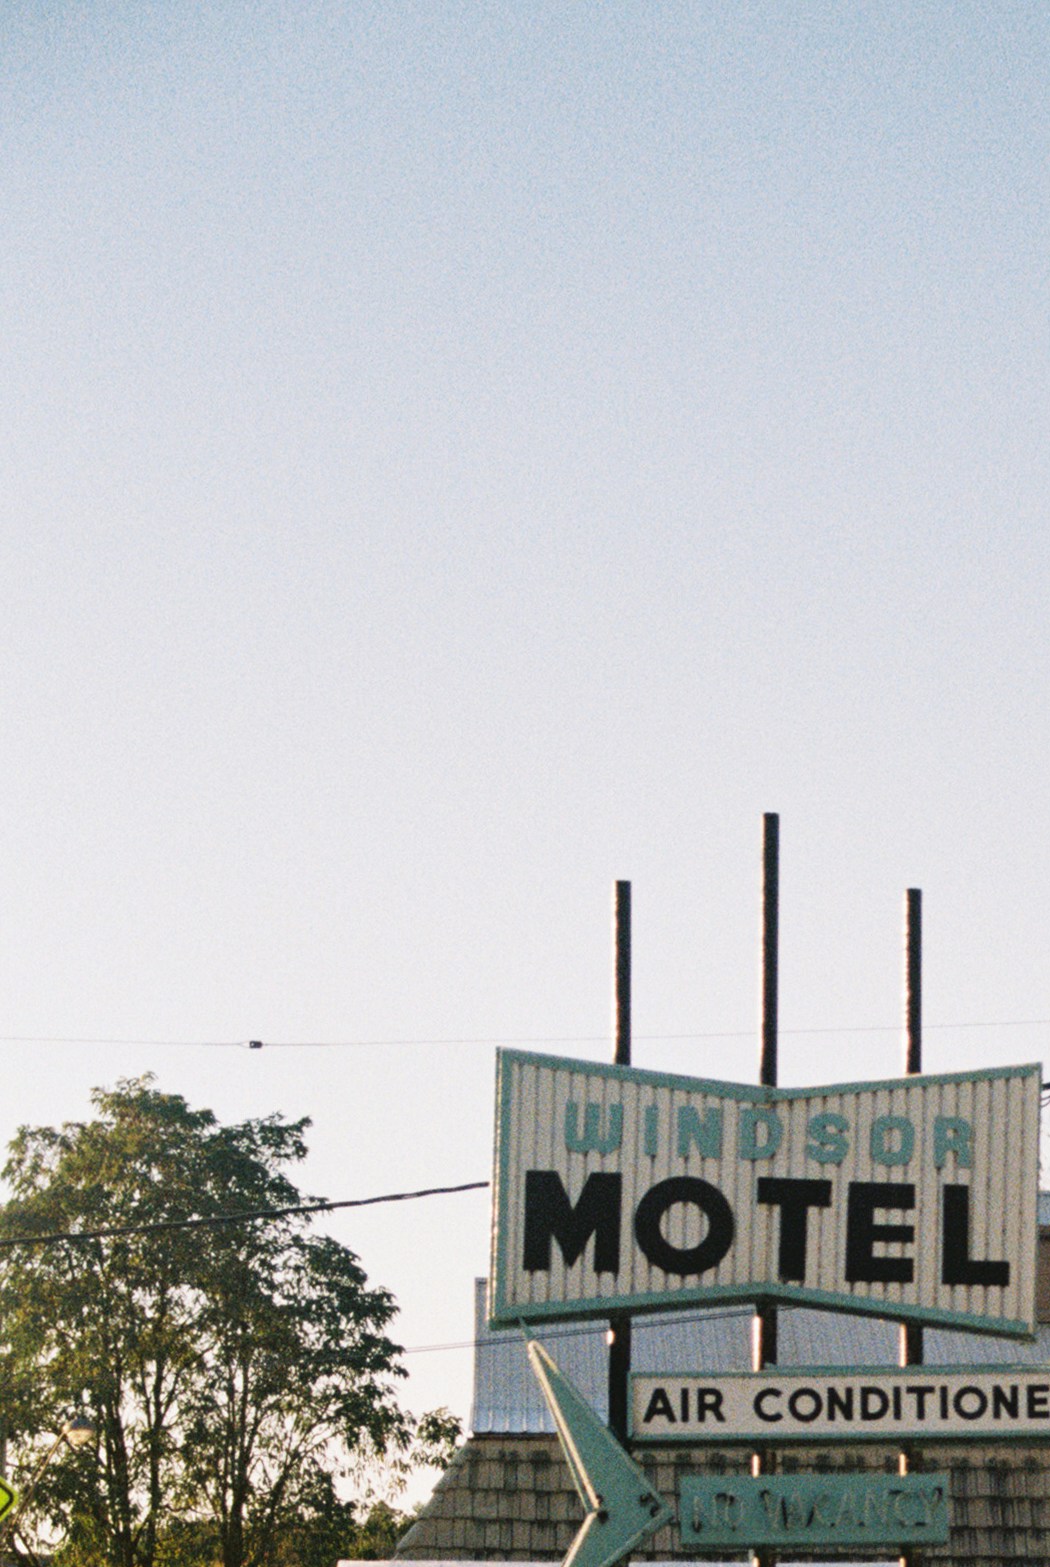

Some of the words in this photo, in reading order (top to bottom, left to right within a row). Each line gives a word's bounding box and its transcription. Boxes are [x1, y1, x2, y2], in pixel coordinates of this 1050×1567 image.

[565, 1101, 975, 1169] WINDSOR
[522, 1169, 1011, 1287] MOTEL
[642, 1387, 726, 1424] AIR
